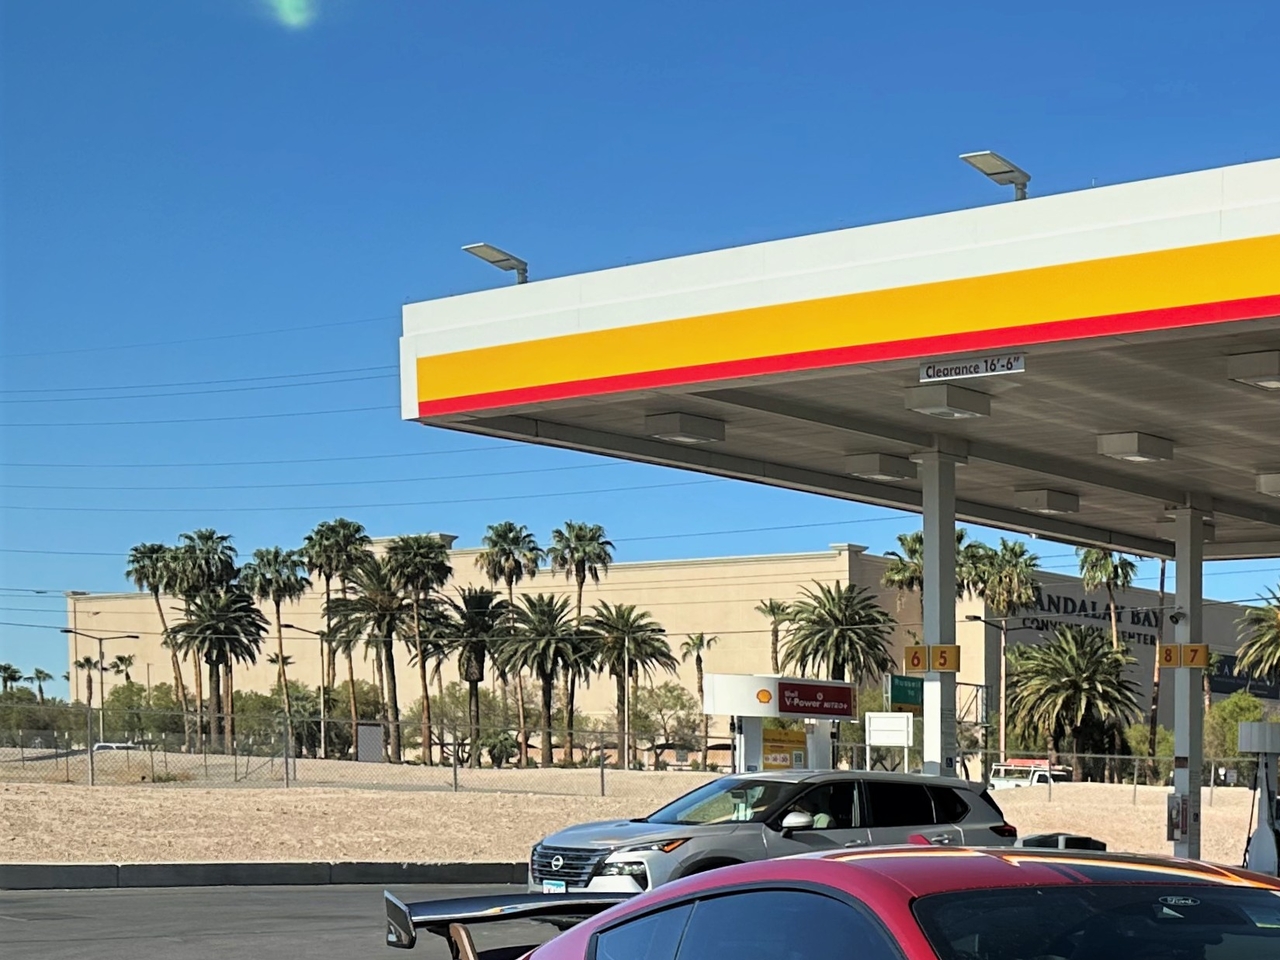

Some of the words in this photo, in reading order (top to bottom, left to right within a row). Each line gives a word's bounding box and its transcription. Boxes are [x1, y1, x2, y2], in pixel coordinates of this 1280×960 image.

[925, 364, 980, 379] Clearance
[1033, 588, 1126, 624] ANDALAY
[1129, 606, 1160, 628] BAY
[911, 650, 921, 668] 6
[938, 650, 948, 667] 5
[1164, 648, 1172, 663] 8
[1189, 648, 1199, 663] 7
[784, 697, 821, 708] V-Power
